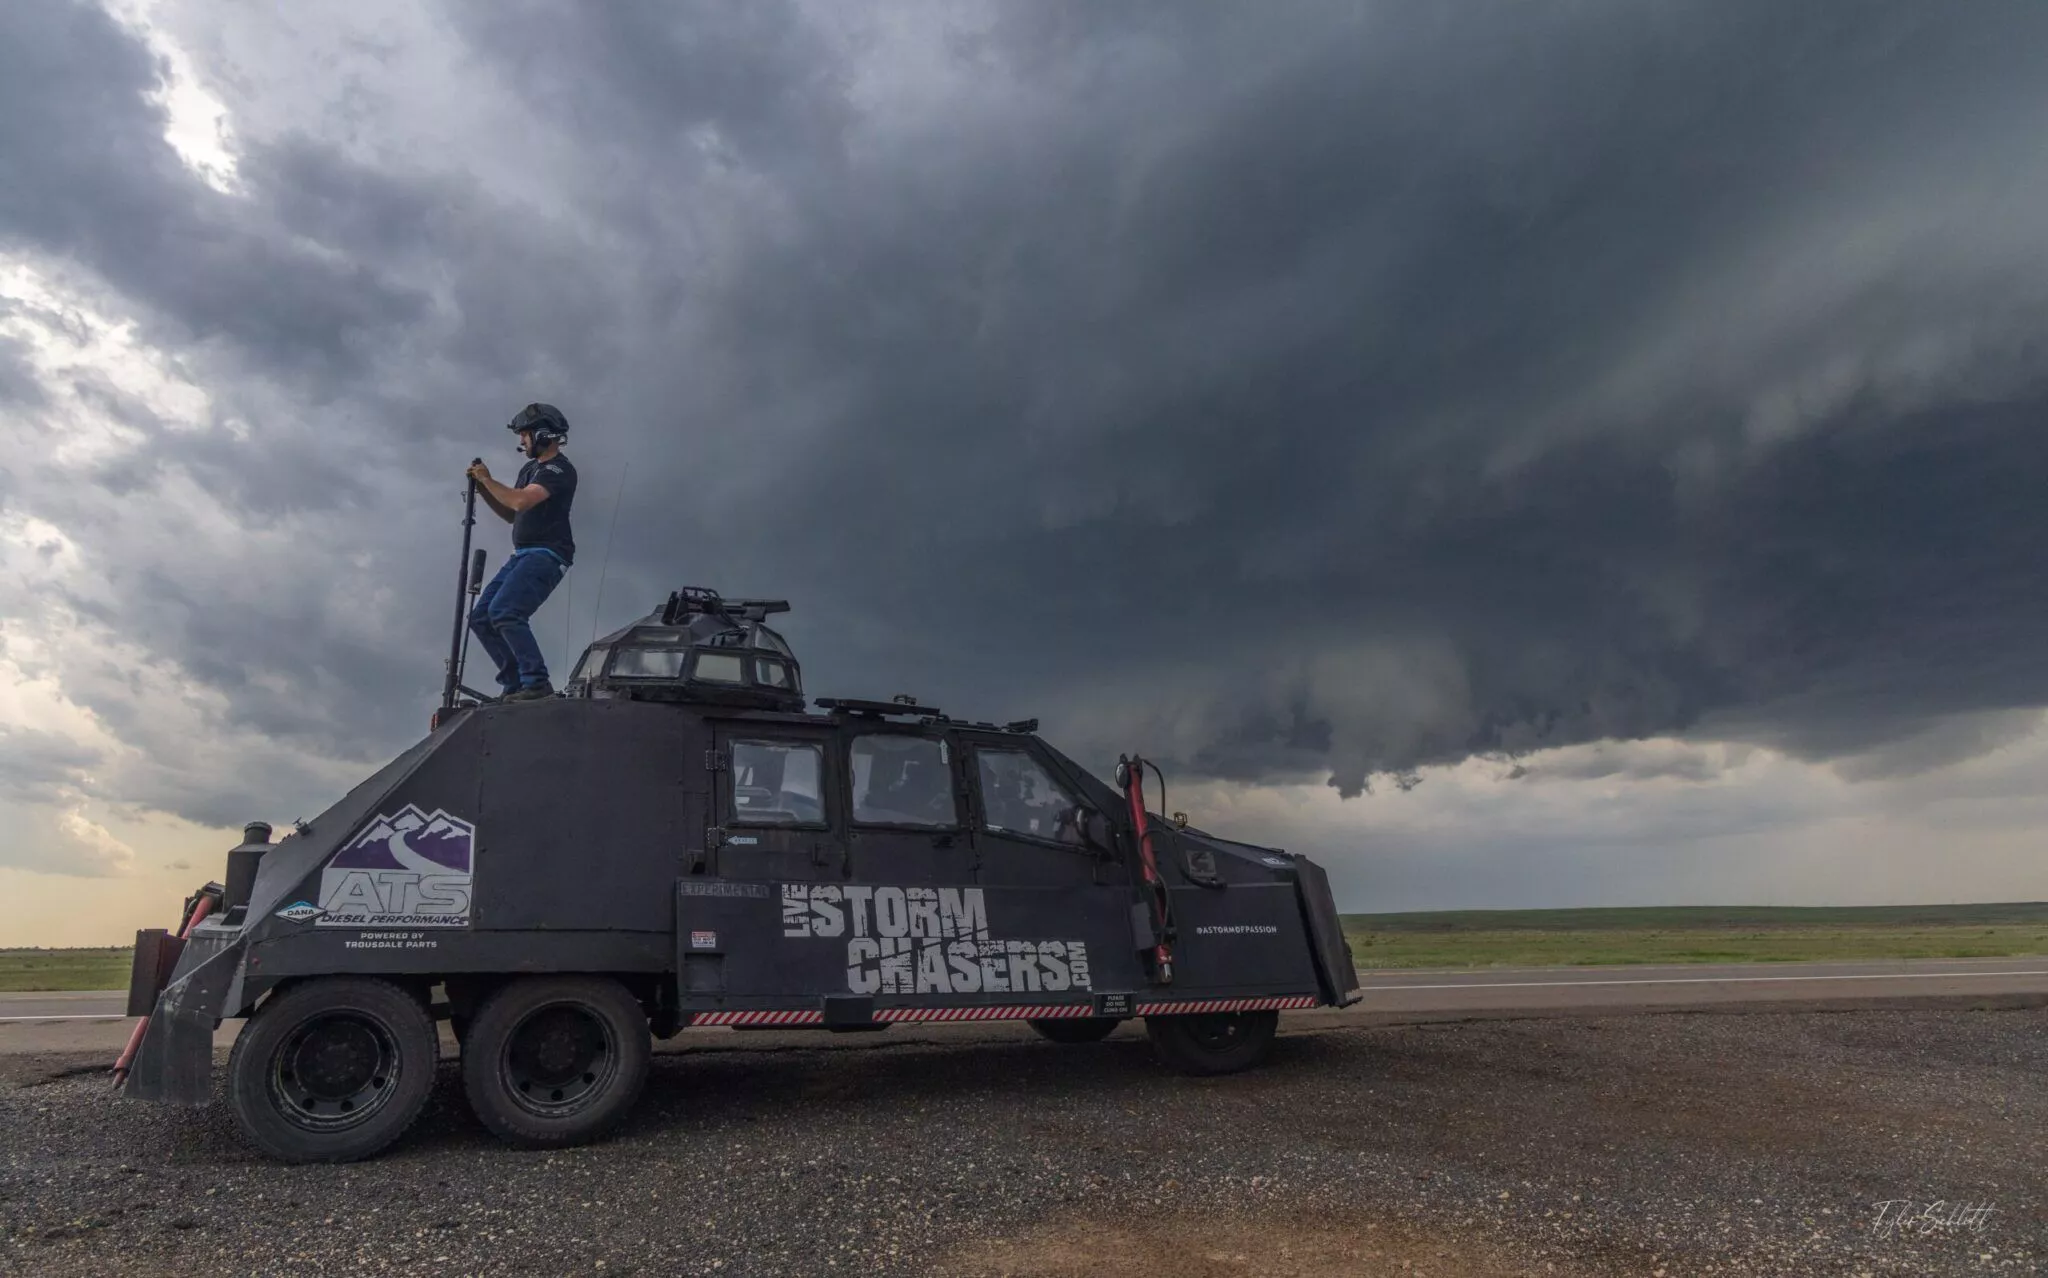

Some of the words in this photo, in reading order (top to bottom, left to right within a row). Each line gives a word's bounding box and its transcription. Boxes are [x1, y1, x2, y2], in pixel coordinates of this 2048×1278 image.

[287, 909, 315, 917] DANA
[325, 871, 472, 915] ATS
[782, 883, 811, 937] LIVE
[810, 885, 989, 941] STORM
[321, 914, 366, 924] DIESEL
[367, 914, 469, 925] PERFORMANCE
[360, 932, 409, 940] POWERED
[411, 932, 425, 940] BY
[345, 941, 403, 949] TROUSDALE
[406, 941, 438, 949] PARTS
[847, 937, 1072, 994] CHASERS
[1066, 941, 1093, 992] .COM
